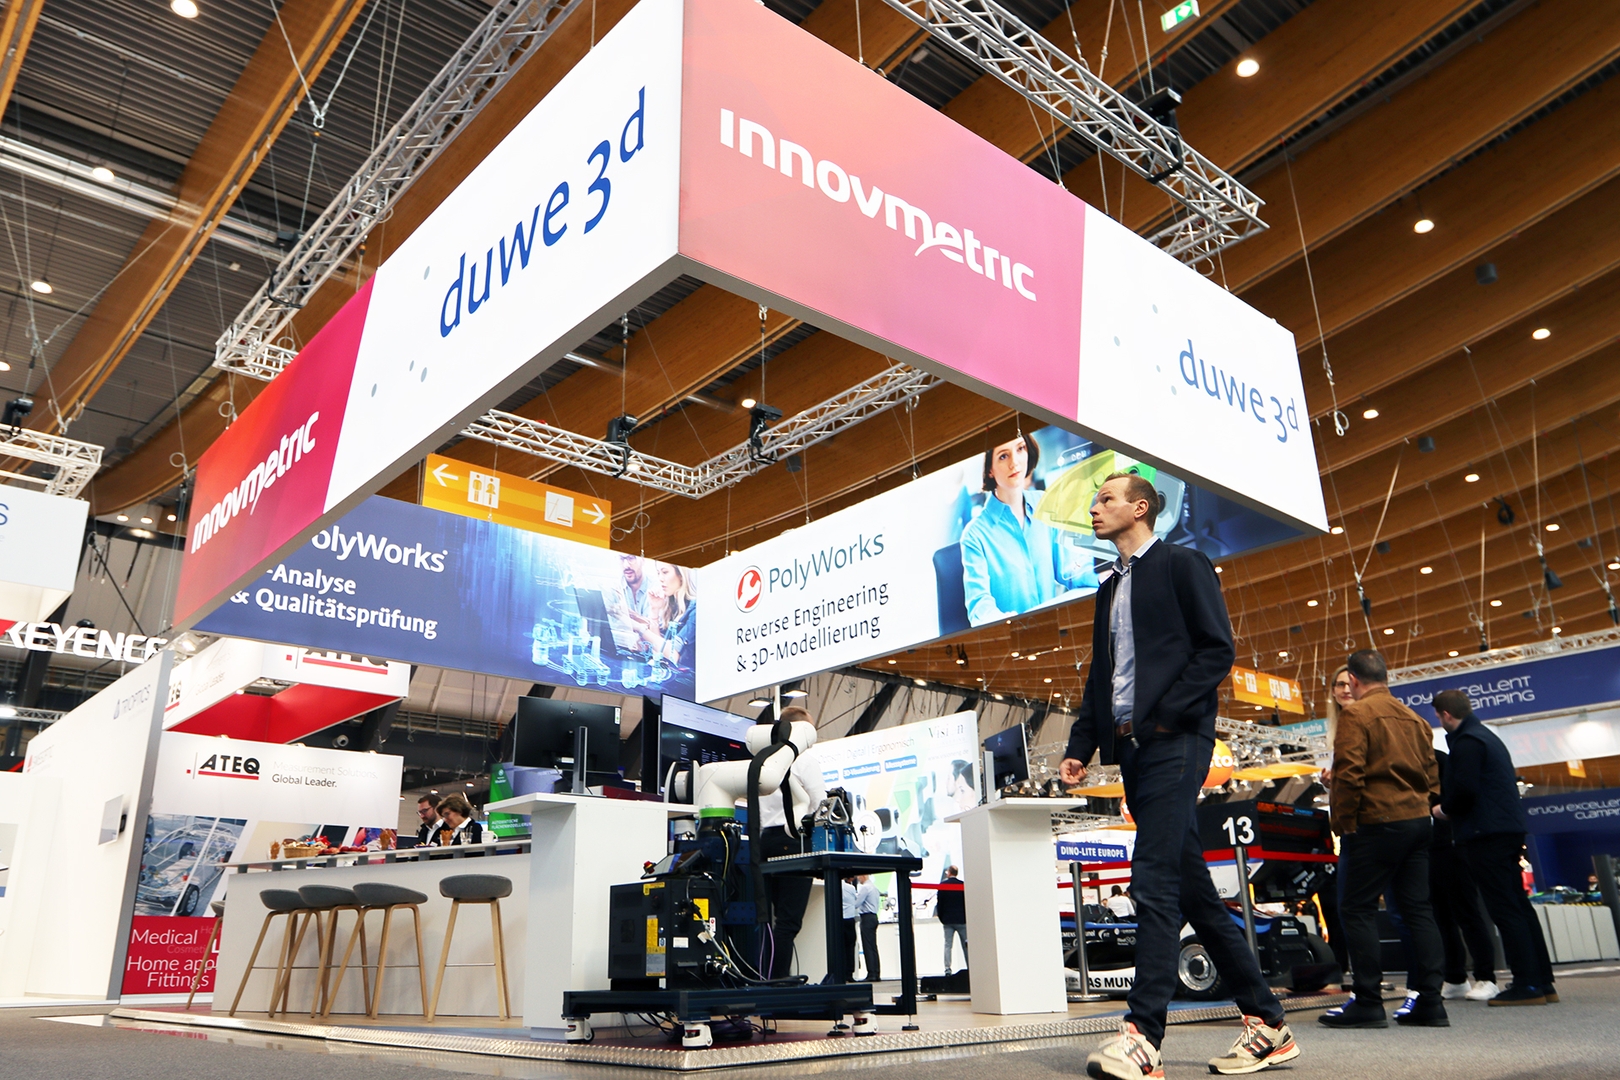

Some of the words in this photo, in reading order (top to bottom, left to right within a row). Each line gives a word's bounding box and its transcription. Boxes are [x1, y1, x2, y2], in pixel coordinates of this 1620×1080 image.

[440, 181, 569, 338] duwe
[1179, 338, 1266, 424] duwe
[312, 525, 446, 573] olyWorks
[769, 534, 885, 593] PolyWorks
[266, 563, 357, 595] -Analyse
[255, 587, 438, 640] Qualitätsprüfung
[736, 616, 789, 645] Reverse
[794, 582, 889, 627] Engineering
[736, 654, 747, 673] &
[751, 616, 881, 673] 3D-Modellierung
[200, 754, 260, 775] ATEQ
[272, 760, 335, 776] Measurement
[272, 773, 303, 785] Global
[304, 776, 338, 788] Leader.
[1222, 816, 1255, 845] 13
[1060, 846, 1097, 857] DINO-LITE
[1098, 847, 1125, 858] EUROPE
[131, 929, 198, 945] Medical
[127, 956, 180, 971] Home
[147, 971, 209, 990] Fittings
[1088, 977, 1101, 988] AS
[1104, 977, 1133, 988] MUN
